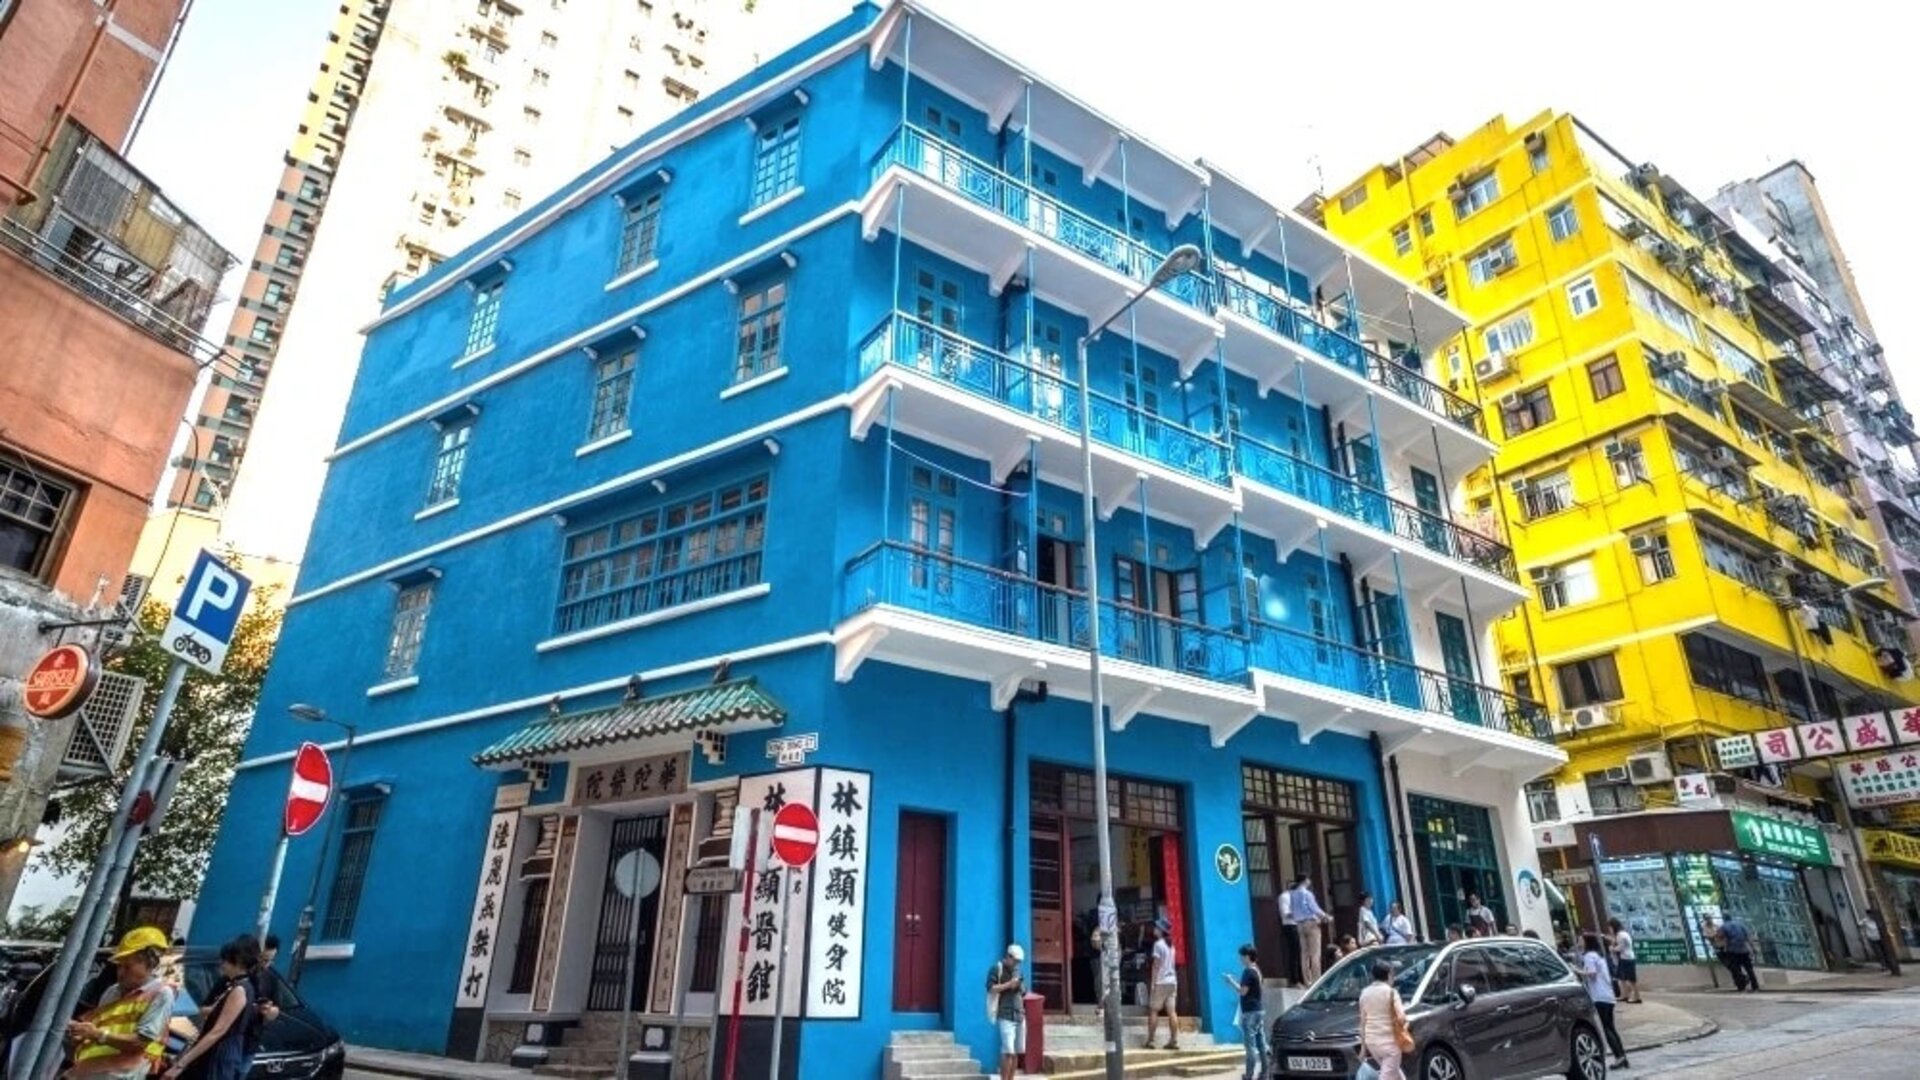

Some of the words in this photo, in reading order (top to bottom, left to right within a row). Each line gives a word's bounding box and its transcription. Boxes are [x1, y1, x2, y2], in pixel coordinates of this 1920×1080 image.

[186, 561, 239, 621] P
[822, 780, 862, 1006] 林鎮顯健身院
